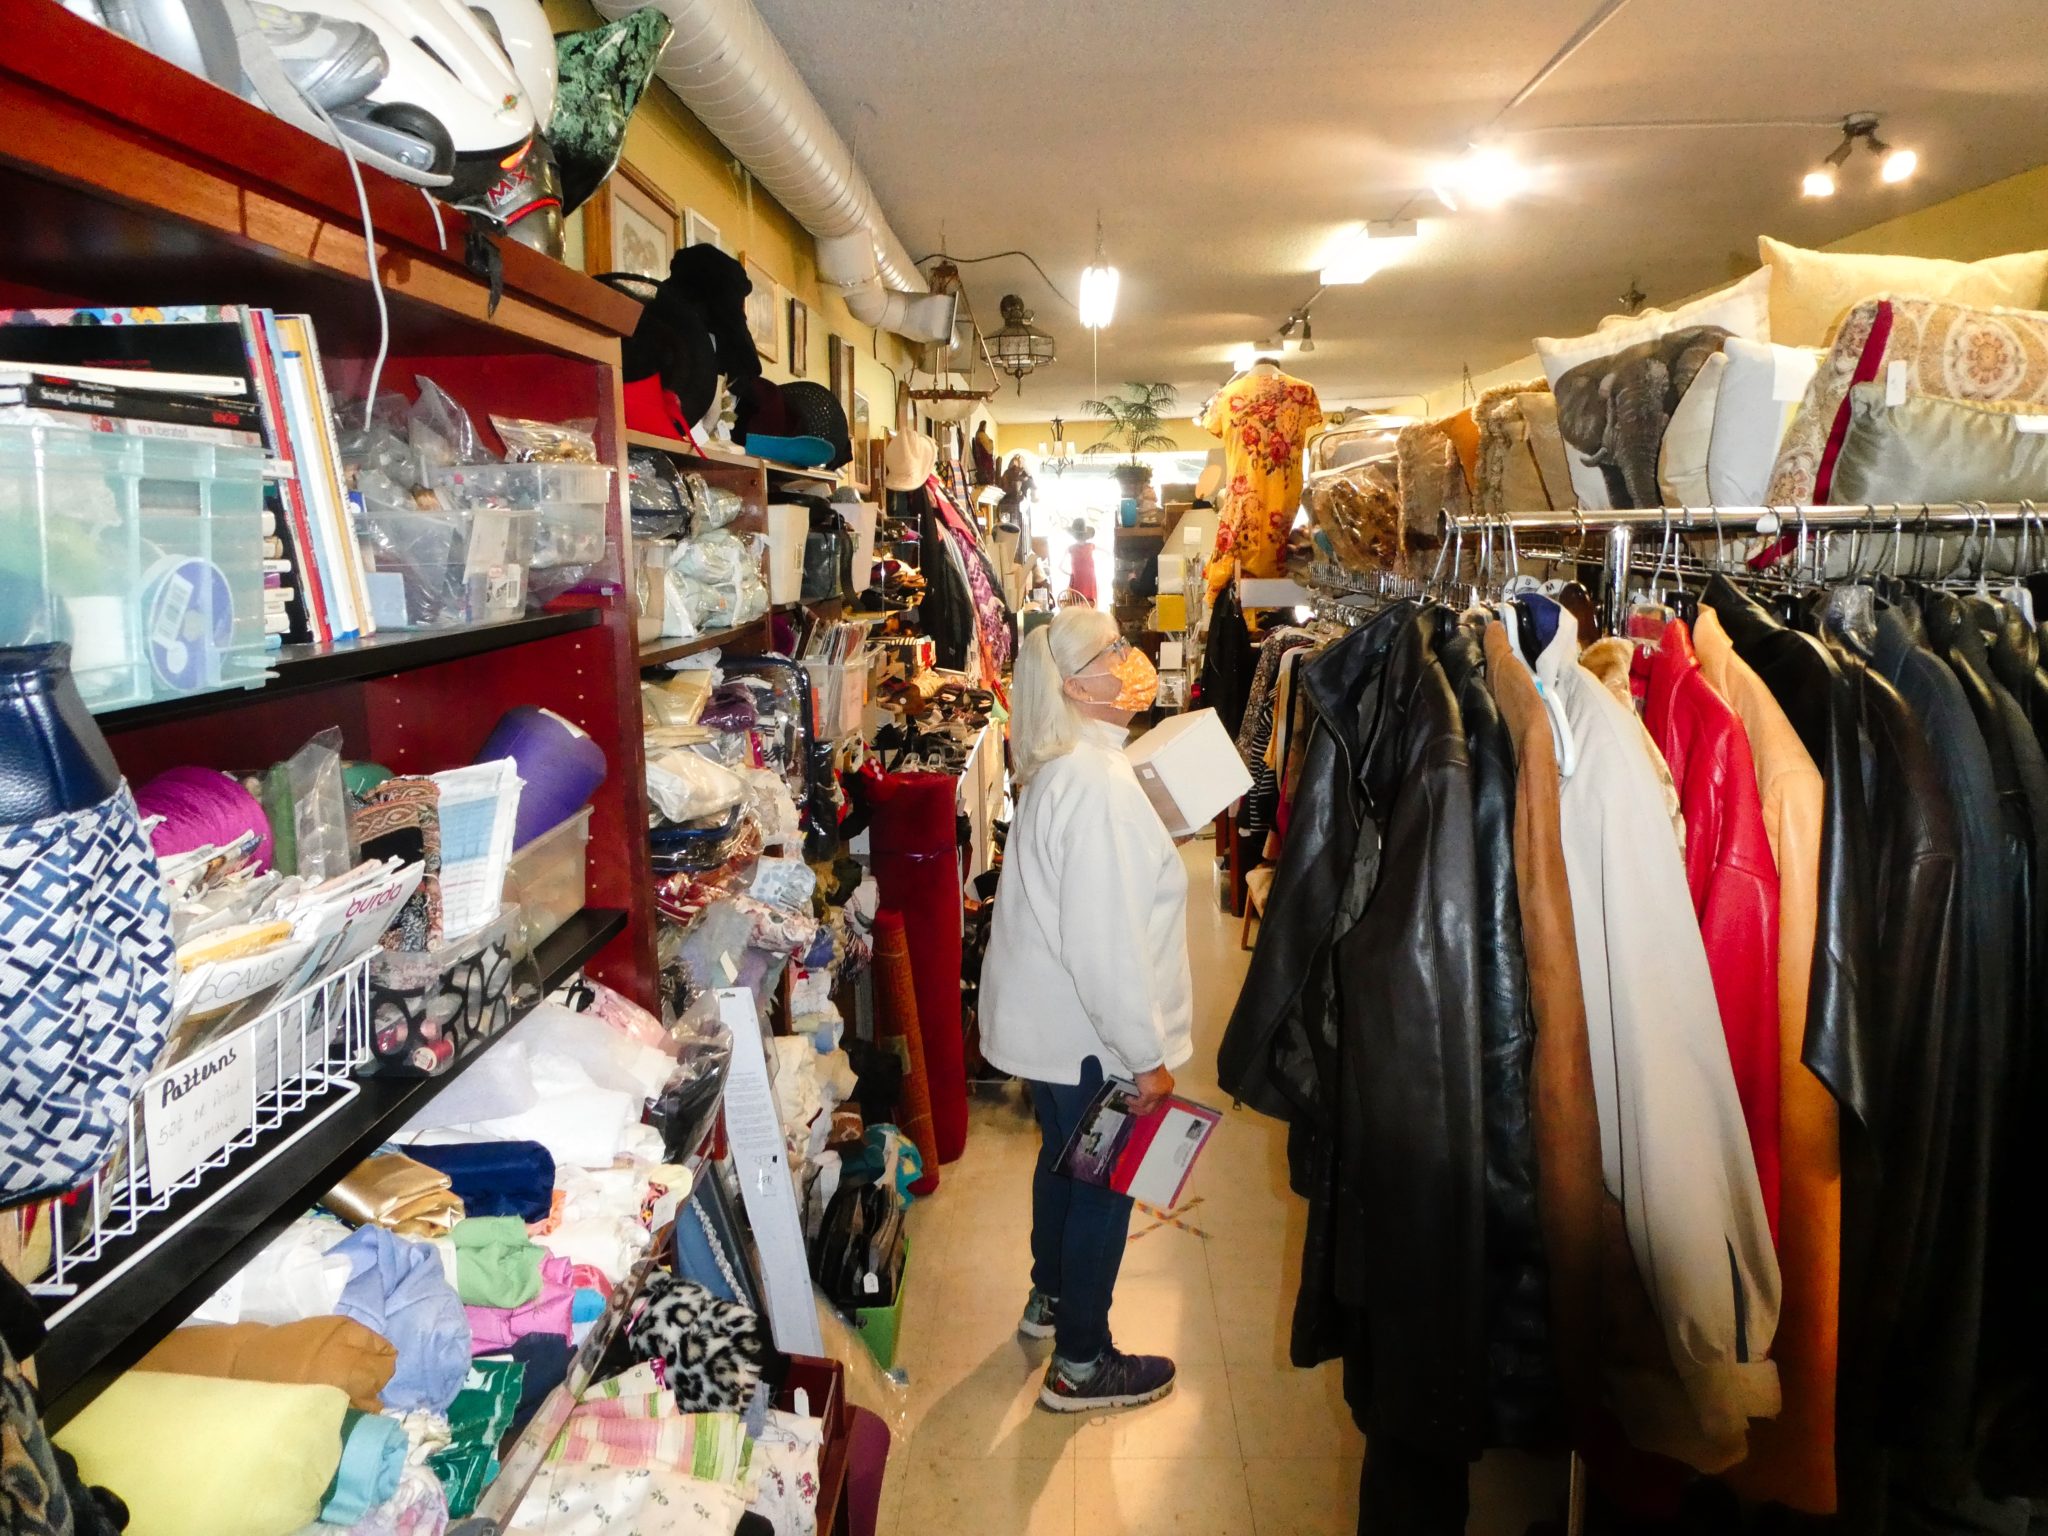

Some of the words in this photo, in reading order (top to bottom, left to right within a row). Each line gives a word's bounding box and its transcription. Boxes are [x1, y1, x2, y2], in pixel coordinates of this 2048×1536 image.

[487, 167, 535, 209] MX
[346, 882, 402, 918] burda
[161, 1047, 237, 1109] Patterns
